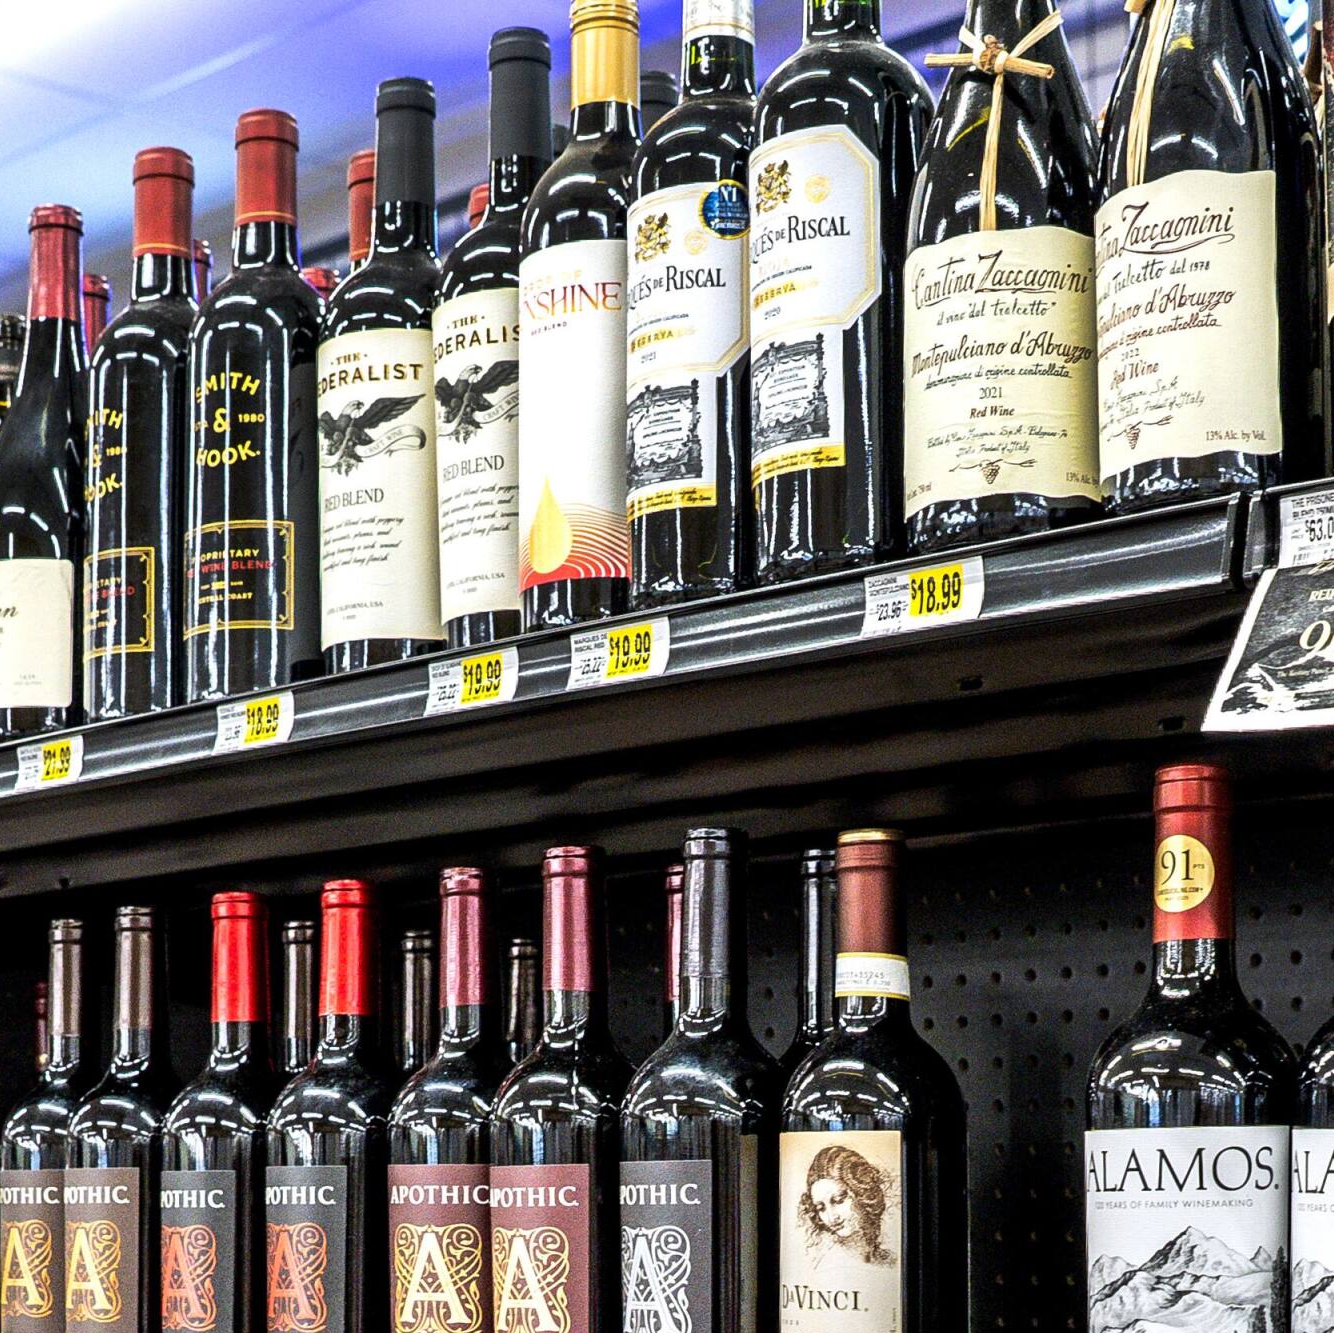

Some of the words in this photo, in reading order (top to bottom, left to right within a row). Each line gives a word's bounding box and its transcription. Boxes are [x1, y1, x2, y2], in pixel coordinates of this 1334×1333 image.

[787, 215, 851, 243] RISCAL
[1121, 201, 1235, 255] Zaccagnini
[666, 265, 727, 292] RISCAL
[912, 257, 976, 310] Cantina
[975, 249, 1094, 295] Zaccagnini
[1189, 260, 1211, 272] 1978
[1144, 284, 1236, 318] d'Abruzzo
[911, 335, 1007, 377] Montepulciano
[1010, 331, 1094, 364] d'Abruzzo
[195, 371, 261, 404] SMITH
[979, 387, 1003, 401] 2021
[238, 413, 265, 424] 1980
[970, 406, 988, 419] Red
[989, 404, 1015, 418] Wine
[196, 440, 261, 467] HOOK.
[461, 455, 505, 476] BLEND
[342, 488, 385, 508] BLEND
[1291, 499, 1307, 508] THE
[910, 571, 962, 615] $18.99
[1308, 588, 1334, 602] RED
[608, 631, 652, 669] $19.99
[462, 665, 502, 696] $19.99
[1161, 850, 1195, 885] 91
[391, 1185, 490, 1205] APOTHIC
[1181, 1198, 1254, 1209] WINEMAKING
